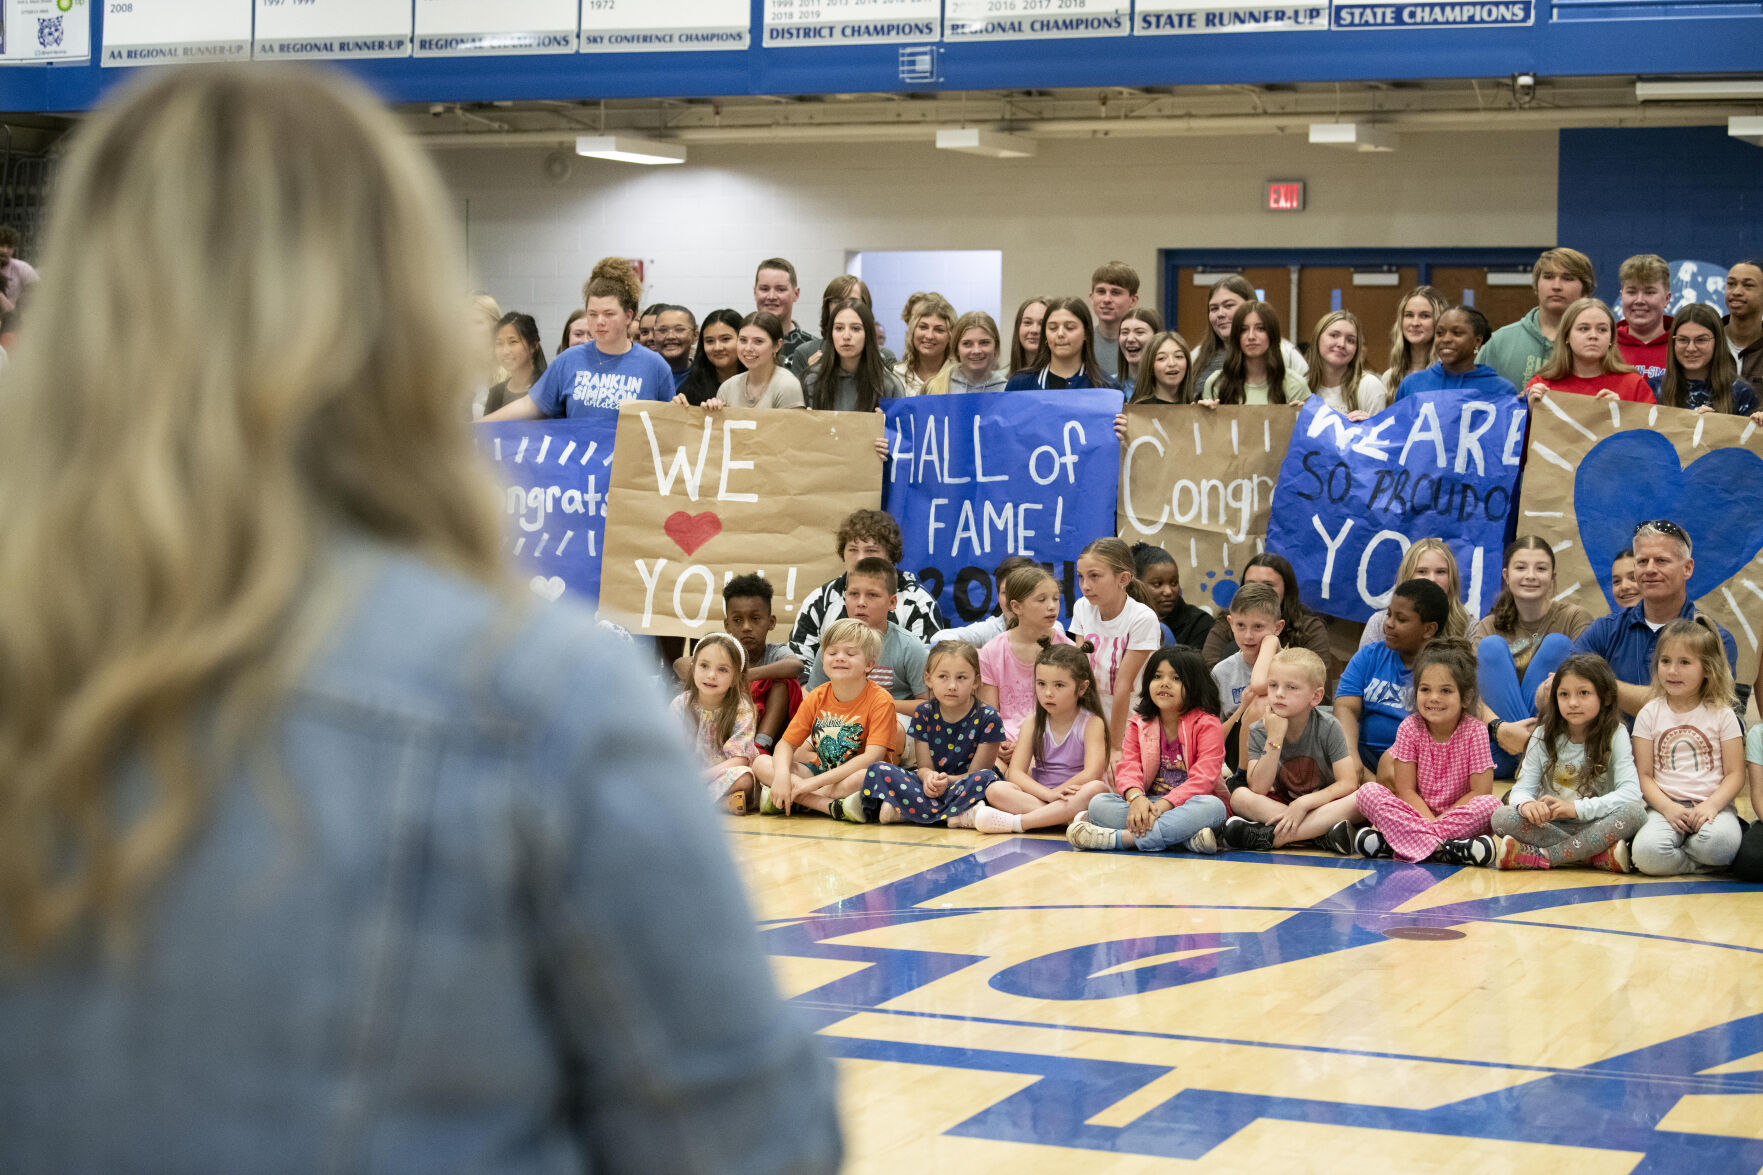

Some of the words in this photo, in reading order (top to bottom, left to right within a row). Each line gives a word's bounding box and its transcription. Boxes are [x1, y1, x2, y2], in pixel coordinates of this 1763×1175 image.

[110, 4, 133, 13] 2008
[590, 1, 615, 10] 1972
[771, 12, 794, 21] 2018
[798, 11, 821, 20] 2019
[1340, 8, 1397, 25] STATE
[1402, 4, 1525, 23] CHAMPIONS
[951, 21, 1025, 35] REONAL
[1030, 17, 1122, 32] CHAMPIONS
[1142, 13, 1197, 30] STATE
[1204, 8, 1321, 27] RUNNER-UP
[586, 34, 605, 45] SKY
[608, 33, 674, 45] CONFERENCE
[678, 31, 744, 43] CHAMPIONS
[769, 25, 836, 41] DISTRICT
[841, 22, 934, 38] CHAMPIONS
[108, 50, 123, 60] AA
[126, 47, 179, 60] REGIONAL
[260, 44, 275, 54] AA
[279, 42, 335, 54] REGIONAL
[339, 39, 405, 52] RUNNER-UP
[1268, 183, 1300, 209] EXIT
[574, 370, 643, 394] FRANKLIN
[572, 385, 638, 402] SIMPSON
[1398, 400, 1528, 477] ARE
[640, 410, 759, 503] WE
[890, 413, 1010, 485] HALL
[1028, 420, 1087, 486] of
[1297, 450, 1352, 504] SO
[1123, 434, 1279, 544] Congr
[928, 495, 1064, 558] FAME!
